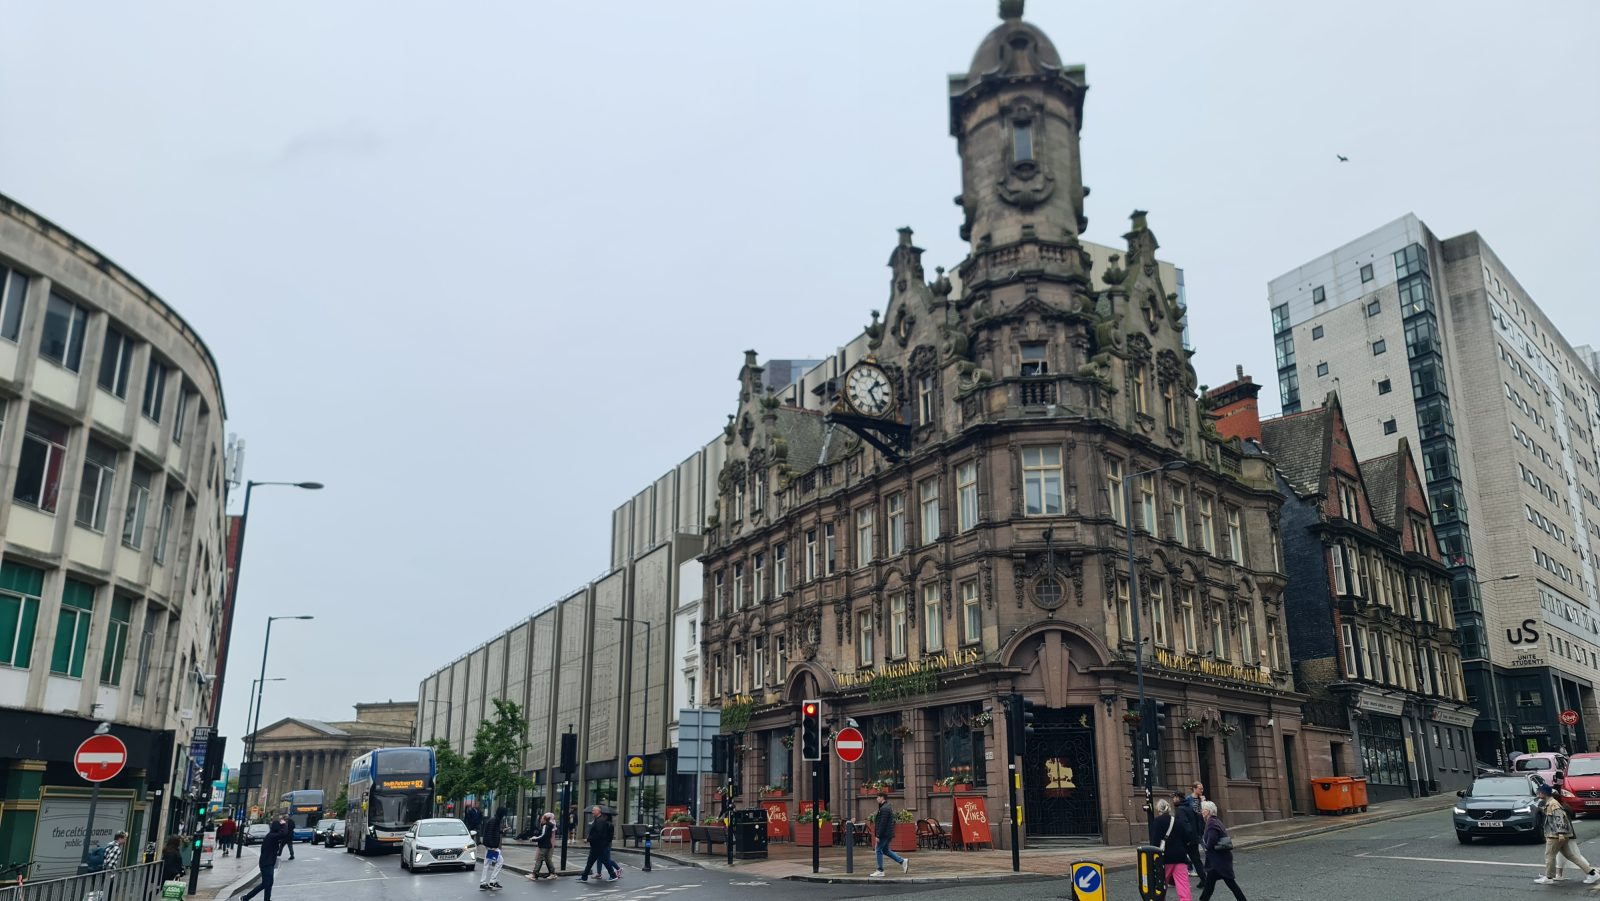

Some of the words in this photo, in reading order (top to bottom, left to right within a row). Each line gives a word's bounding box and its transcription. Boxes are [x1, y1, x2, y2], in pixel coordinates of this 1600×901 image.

[952, 646, 978, 667] ALES
[1511, 658, 1544, 666] STUDENTS
[766, 811, 787, 823] VINES
[958, 807, 987, 825] VINES
[52, 826, 65, 838] the
[64, 838, 82, 849] public
